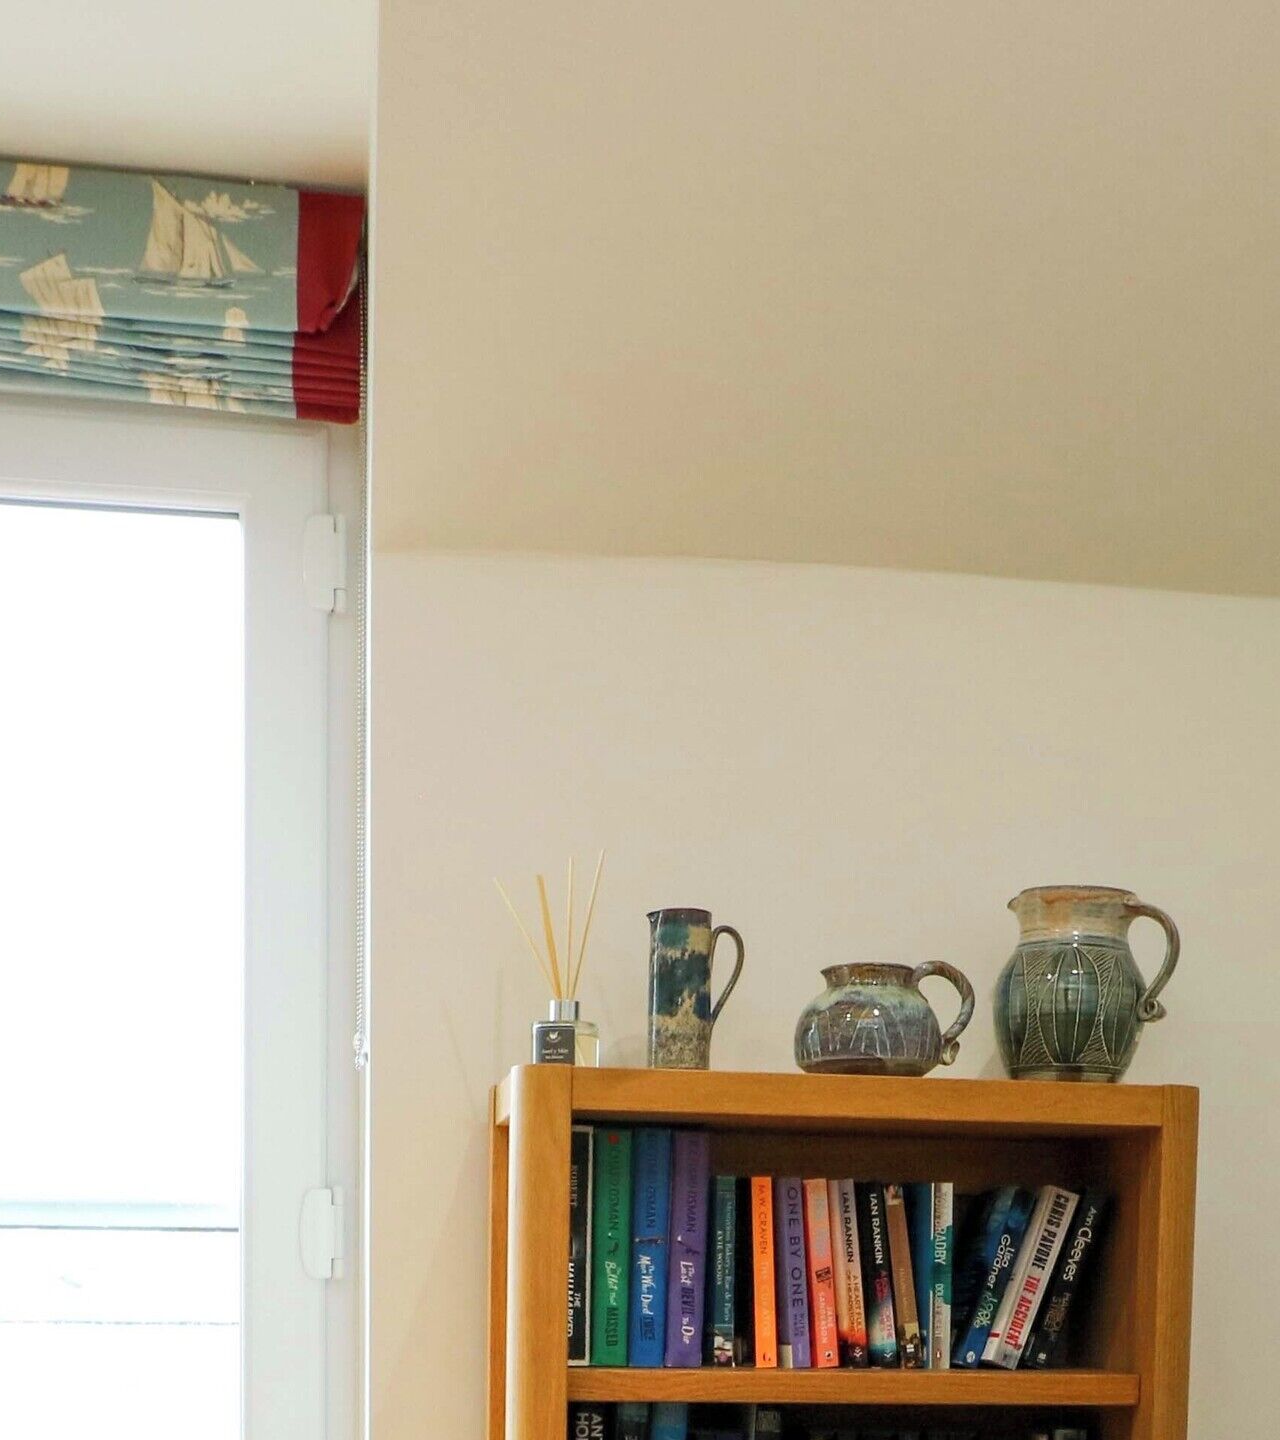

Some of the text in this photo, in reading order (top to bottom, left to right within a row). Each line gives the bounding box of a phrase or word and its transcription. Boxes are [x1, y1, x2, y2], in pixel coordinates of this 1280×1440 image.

[609, 1187, 620, 1231] OSMAN
[646, 1186, 657, 1230] OSMAN
[685, 1190, 697, 1233] OSMAN
[869, 1193, 879, 1215] IAN
[758, 1210, 768, 1255] CRAVEN
[787, 1187, 803, 1307] ONE BY ONE
[841, 1192, 855, 1263] IAN RANKIN
[871, 1217, 884, 1264] RANKIN
[934, 1220, 947, 1265] BRADBY
[1063, 1205, 1098, 1282] Ann Cleeves
[605, 1261, 619, 1291] Bullet
[723, 1244, 733, 1268] Bakery
[987, 1234, 1011, 1289] Gardner
[1002, 1245, 1014, 1268] Lisa
[1004, 1194, 1069, 1350] CHRIS PAVONE THE ACCIDENT
[574, 1293, 582, 1308] THE
[640, 1294, 654, 1315] Died
[681, 1286, 696, 1316] DEVIL
[724, 1275, 732, 1292] Rue
[853, 1283, 862, 1310] HEART
[606, 1307, 620, 1347] MISSED
[680, 1325, 695, 1345] Die
[819, 1293, 827, 1344] SANDERSON
